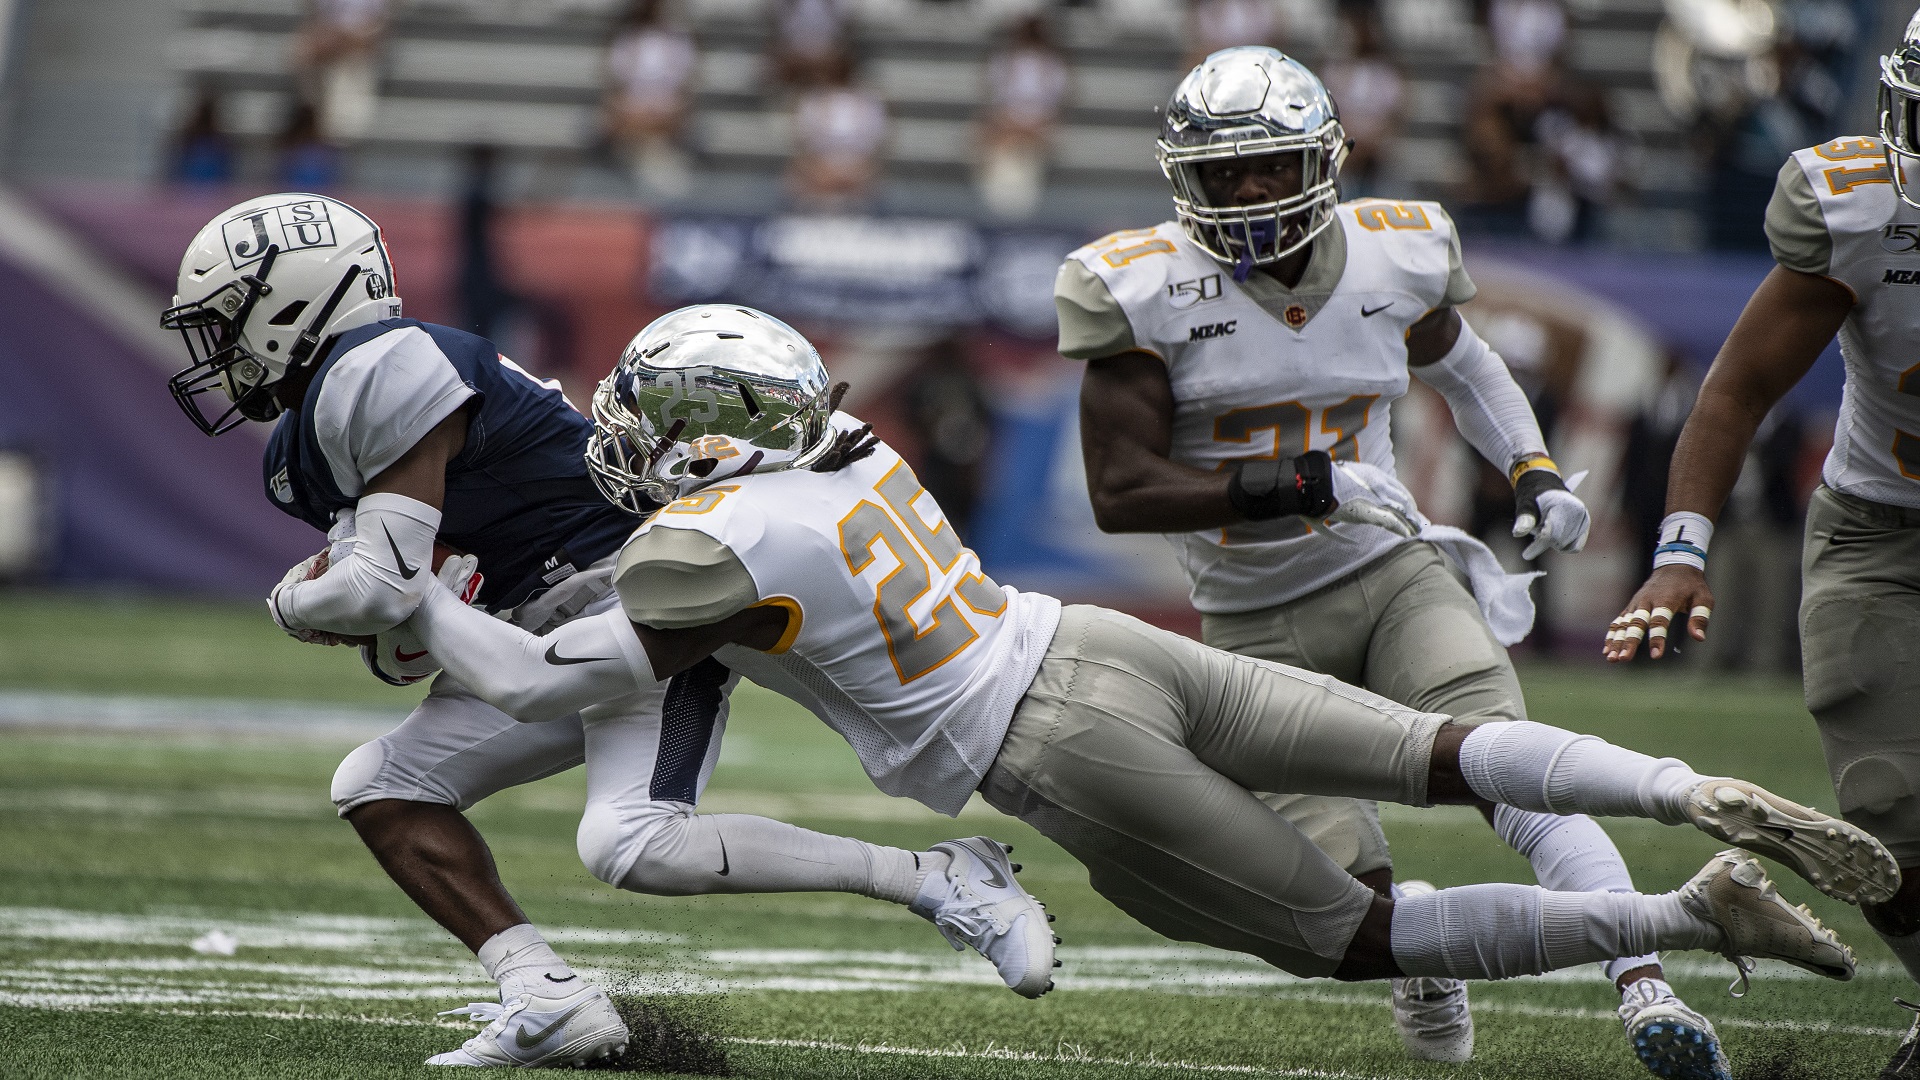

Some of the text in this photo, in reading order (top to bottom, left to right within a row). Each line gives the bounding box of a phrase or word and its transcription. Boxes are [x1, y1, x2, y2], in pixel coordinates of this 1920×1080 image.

[1812, 136, 1908, 196] 31
[1350, 198, 1433, 233] 2
[1883, 225, 1920, 254] 15
[1168, 273, 1222, 309] 150
[1882, 269, 1920, 286] MEA
[1189, 320, 1238, 342] MEAC
[655, 365, 720, 428] 25
[1213, 393, 1382, 547] 21
[544, 556, 559, 570] M
[836, 457, 1008, 686] 25
